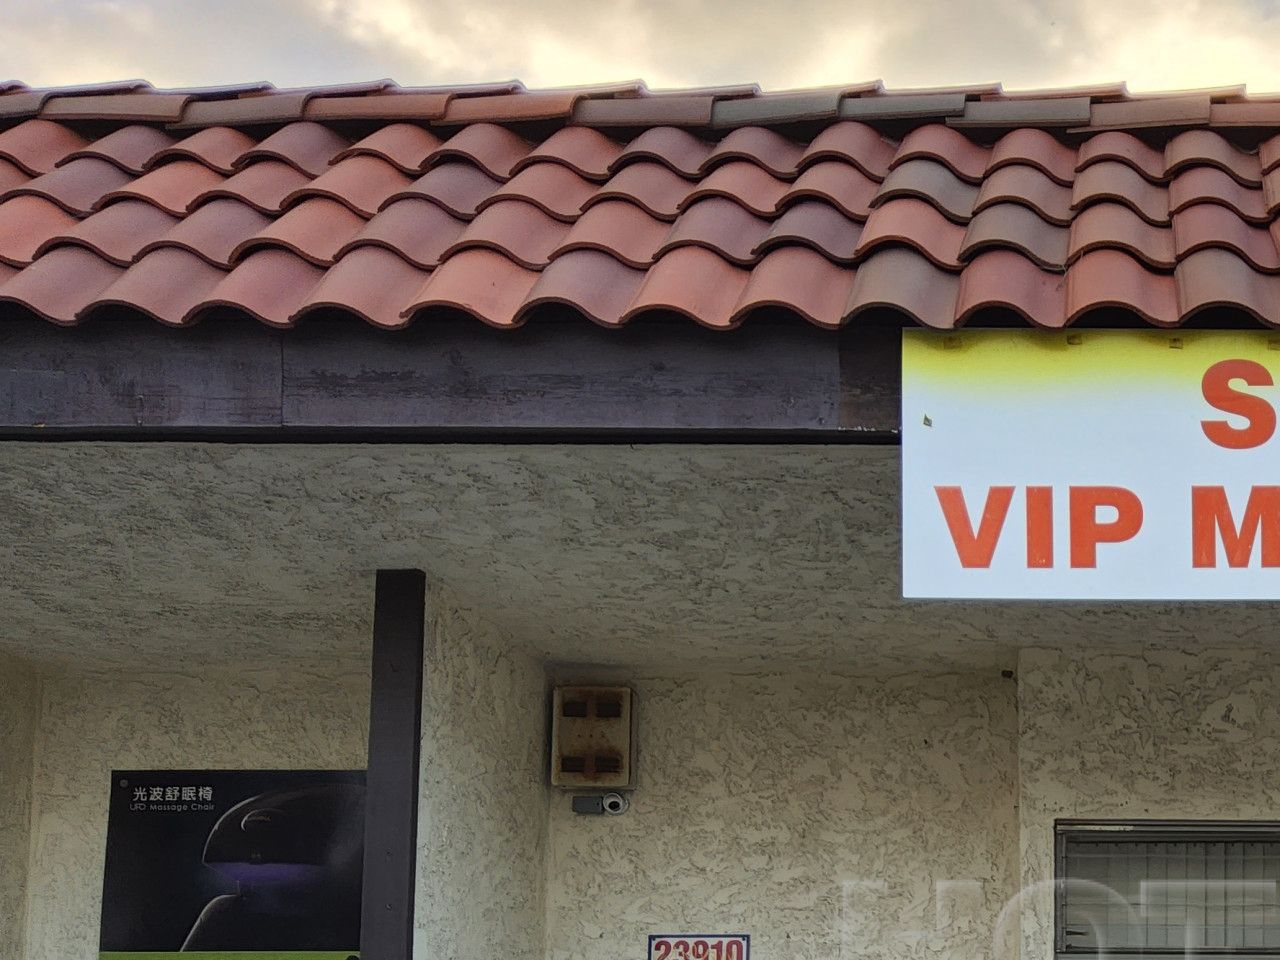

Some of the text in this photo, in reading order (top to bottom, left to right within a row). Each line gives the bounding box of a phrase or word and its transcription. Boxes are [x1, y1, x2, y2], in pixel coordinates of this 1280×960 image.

[934, 485, 1145, 569] VIP
[133, 786, 213, 801] 光波舒眠椅
[149, 803, 188, 812] Massage
[190, 802, 215, 811] Chair
